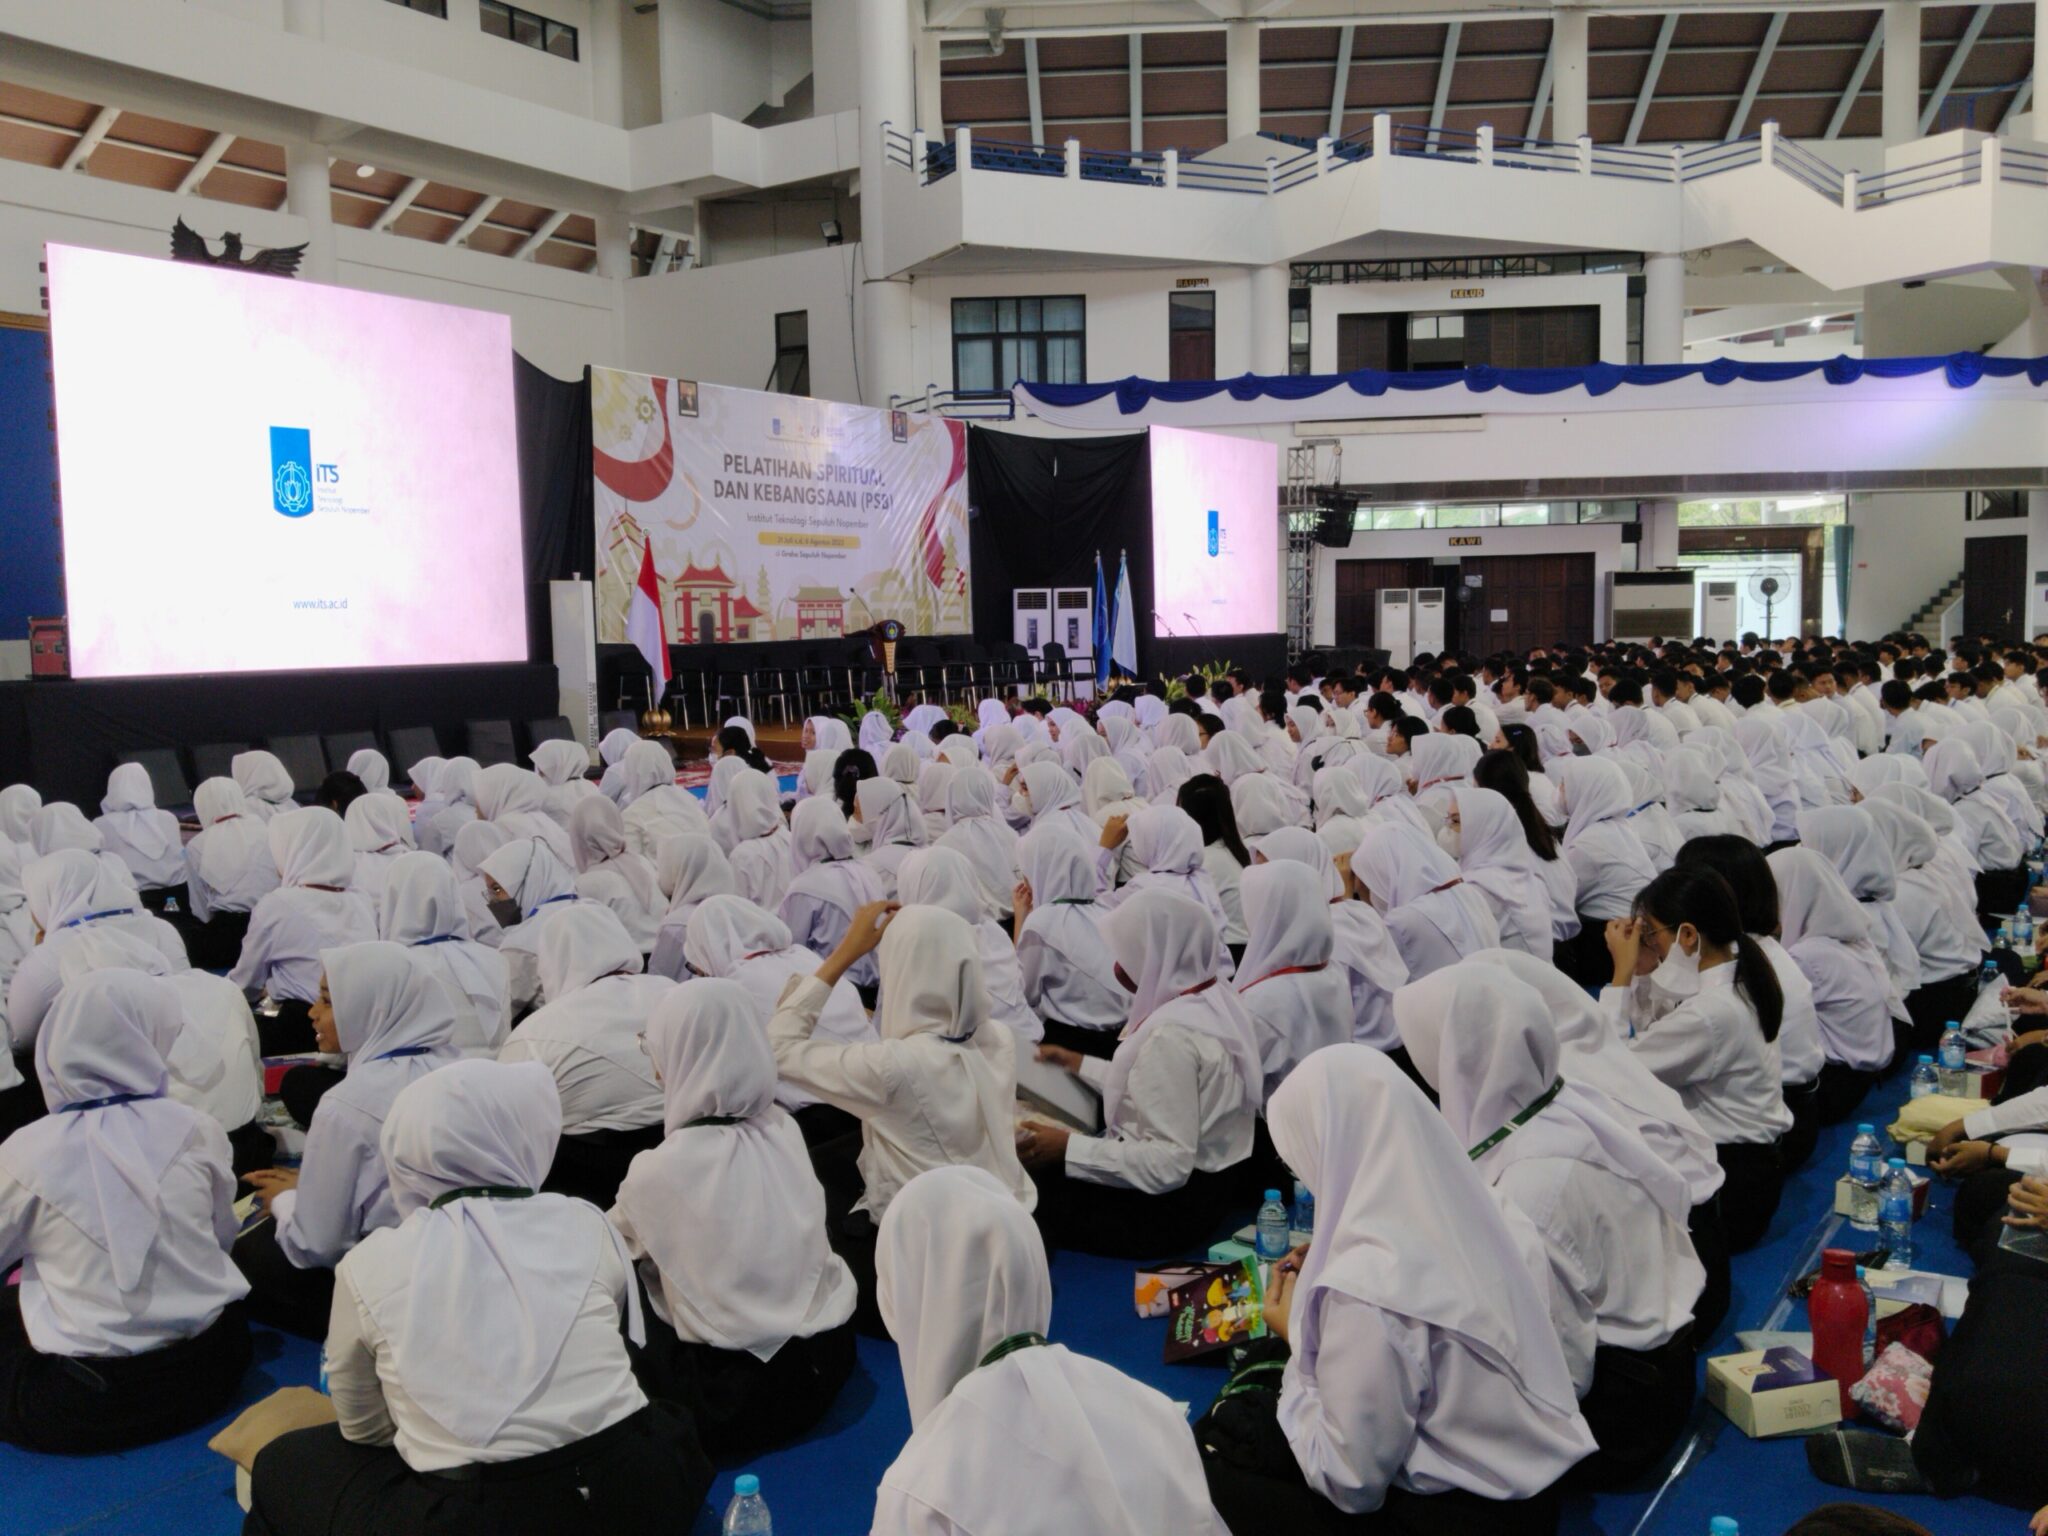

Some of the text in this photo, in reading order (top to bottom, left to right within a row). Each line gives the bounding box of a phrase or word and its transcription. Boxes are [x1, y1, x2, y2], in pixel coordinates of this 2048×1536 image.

[1452, 289, 1484, 298] KELUD
[724, 454, 812, 480] PELATIHAN
[714, 480, 749, 500] DAN
[754, 482, 857, 508] KEBANGSAAN
[747, 513, 869, 529] Institut Teknologi Sepuluh Nopember
[1450, 537, 1482, 546] KAWI
[292, 598, 348, 609] www.its.ac.id
